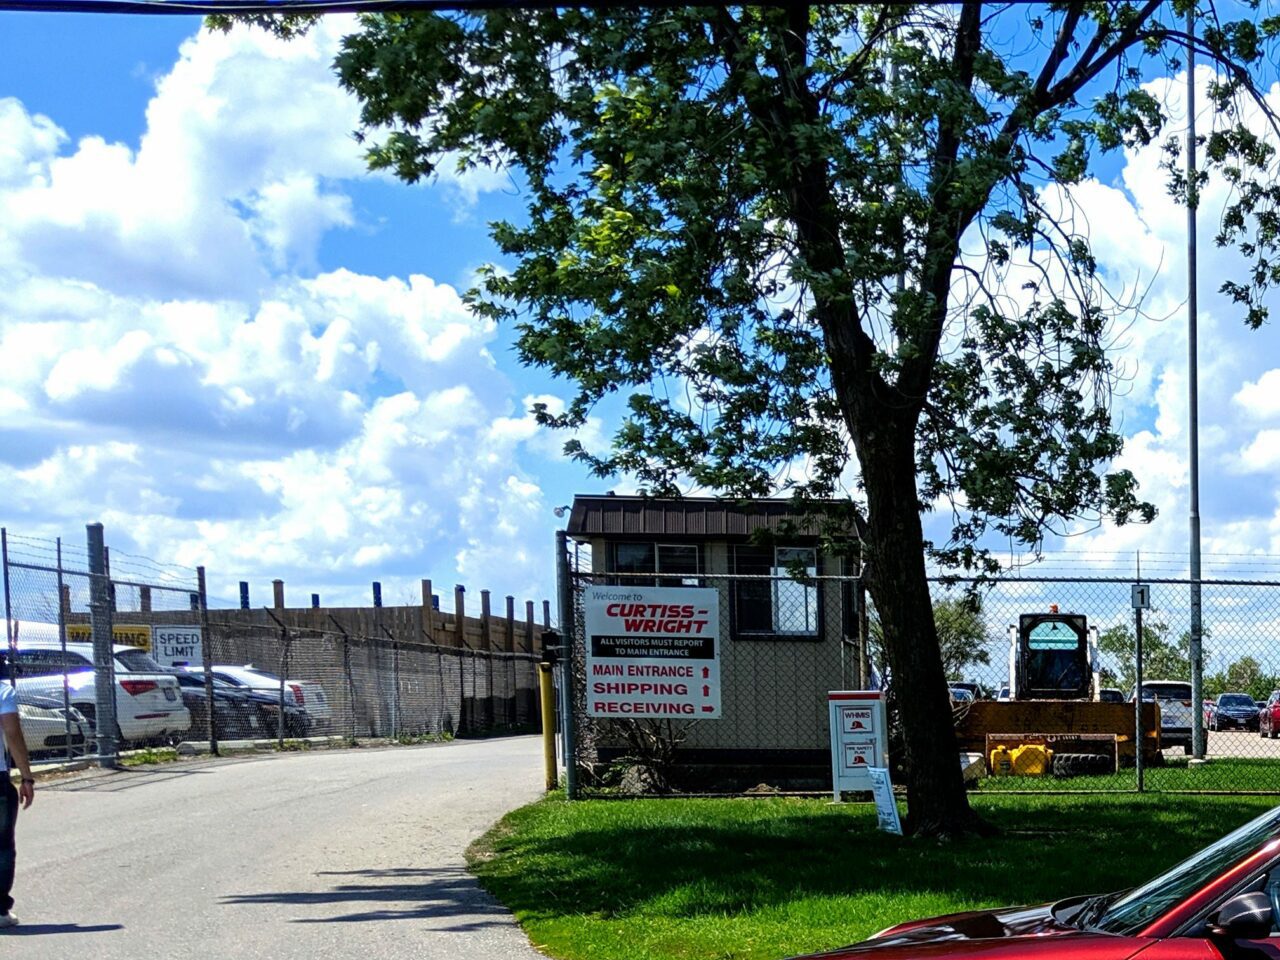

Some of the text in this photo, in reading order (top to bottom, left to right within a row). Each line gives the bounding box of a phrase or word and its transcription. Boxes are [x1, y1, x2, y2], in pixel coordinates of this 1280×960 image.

[592, 591, 643, 601] Welcome to
[1137, 588, 1145, 605] 1
[624, 619, 709, 634] WRIGHT
[159, 633, 200, 645] SPEED
[600, 637, 704, 648] ALL VISITORS MUST REPORT
[164, 646, 195, 657] LIMIT
[615, 647, 690, 657] TO MAIN ENTRANCE
[593, 664, 694, 678] MAIN ENTRANCE
[593, 682, 689, 696] SHIPPING
[594, 702, 695, 715] RECEIVING
[845, 711, 871, 719] WHMIS
